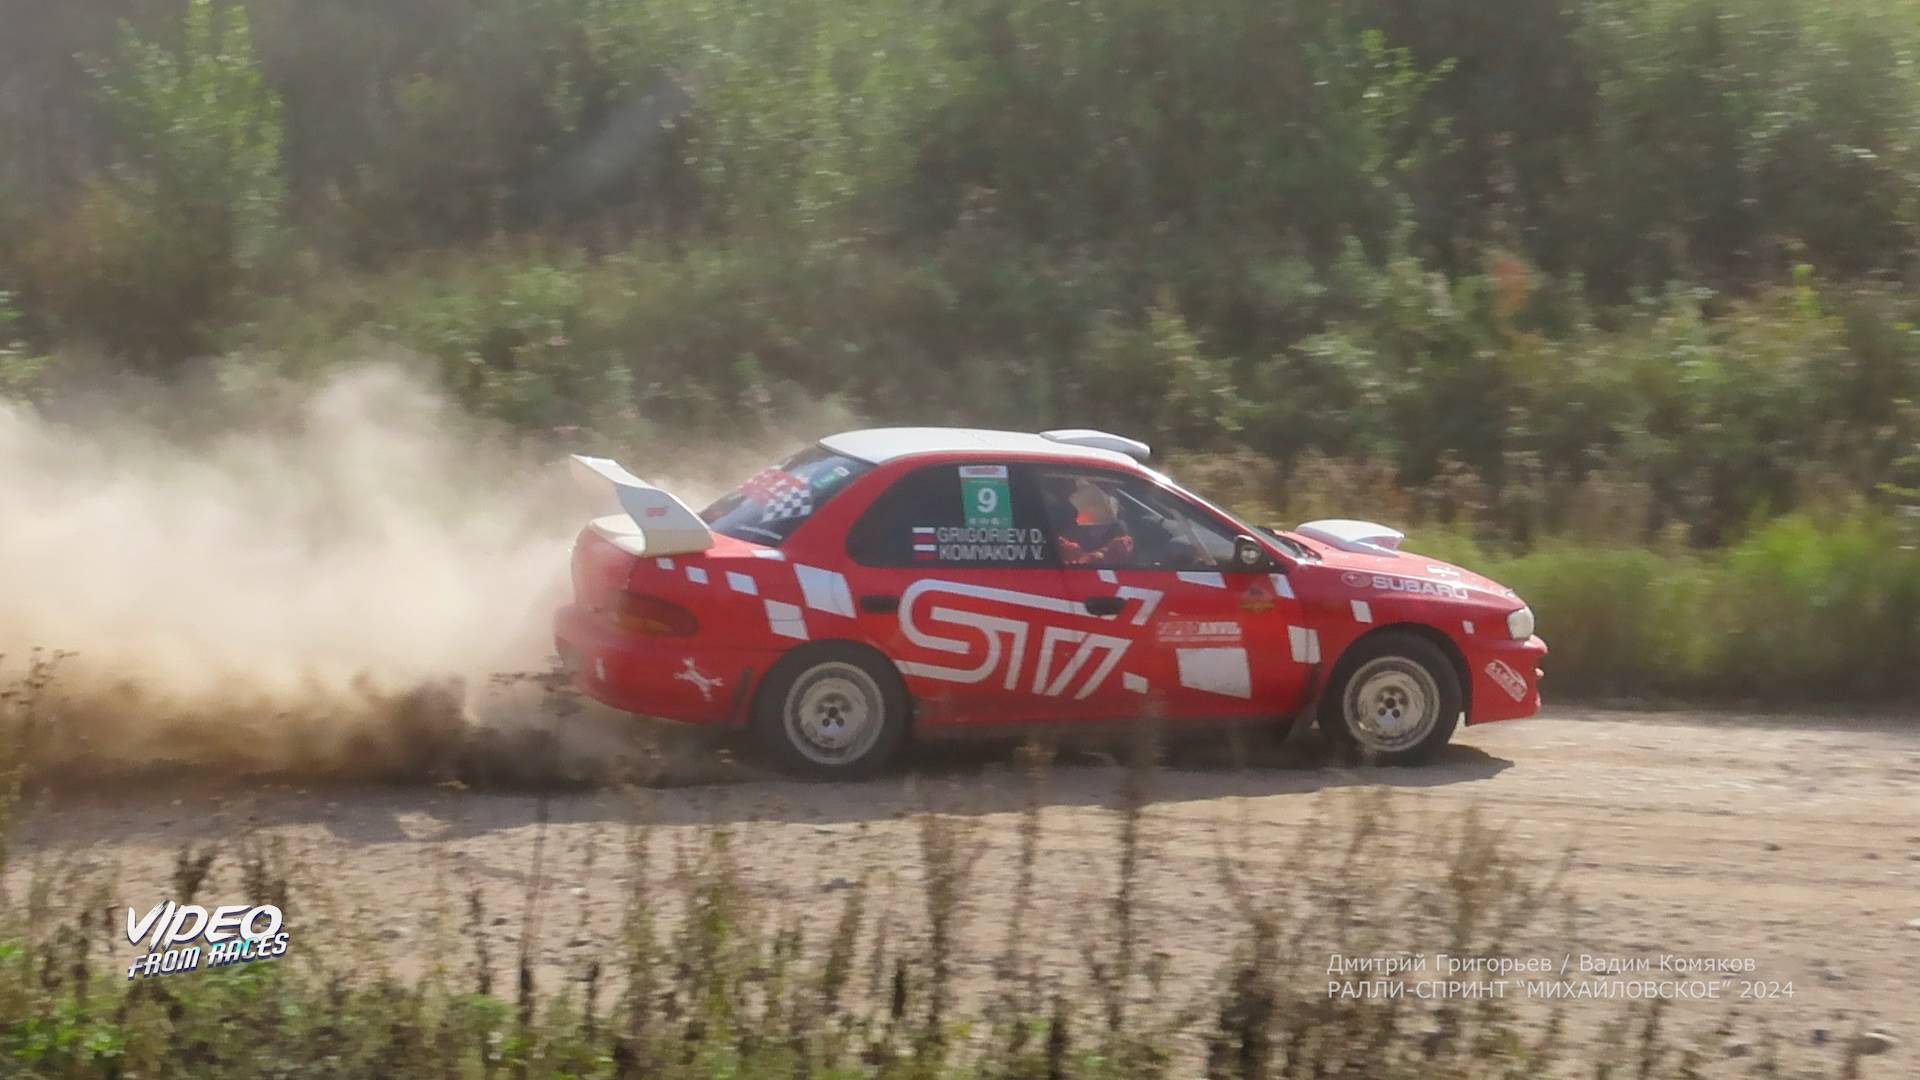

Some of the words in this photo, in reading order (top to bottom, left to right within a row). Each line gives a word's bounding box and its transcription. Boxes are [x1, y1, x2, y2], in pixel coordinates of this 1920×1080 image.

[977, 487, 998, 513] 9
[936, 527, 1026, 543] GRIGORIEV
[1029, 528, 1047, 544] D.
[939, 544, 1026, 561] KOMYAKOV
[1370, 575, 1469, 600] SUBARU
